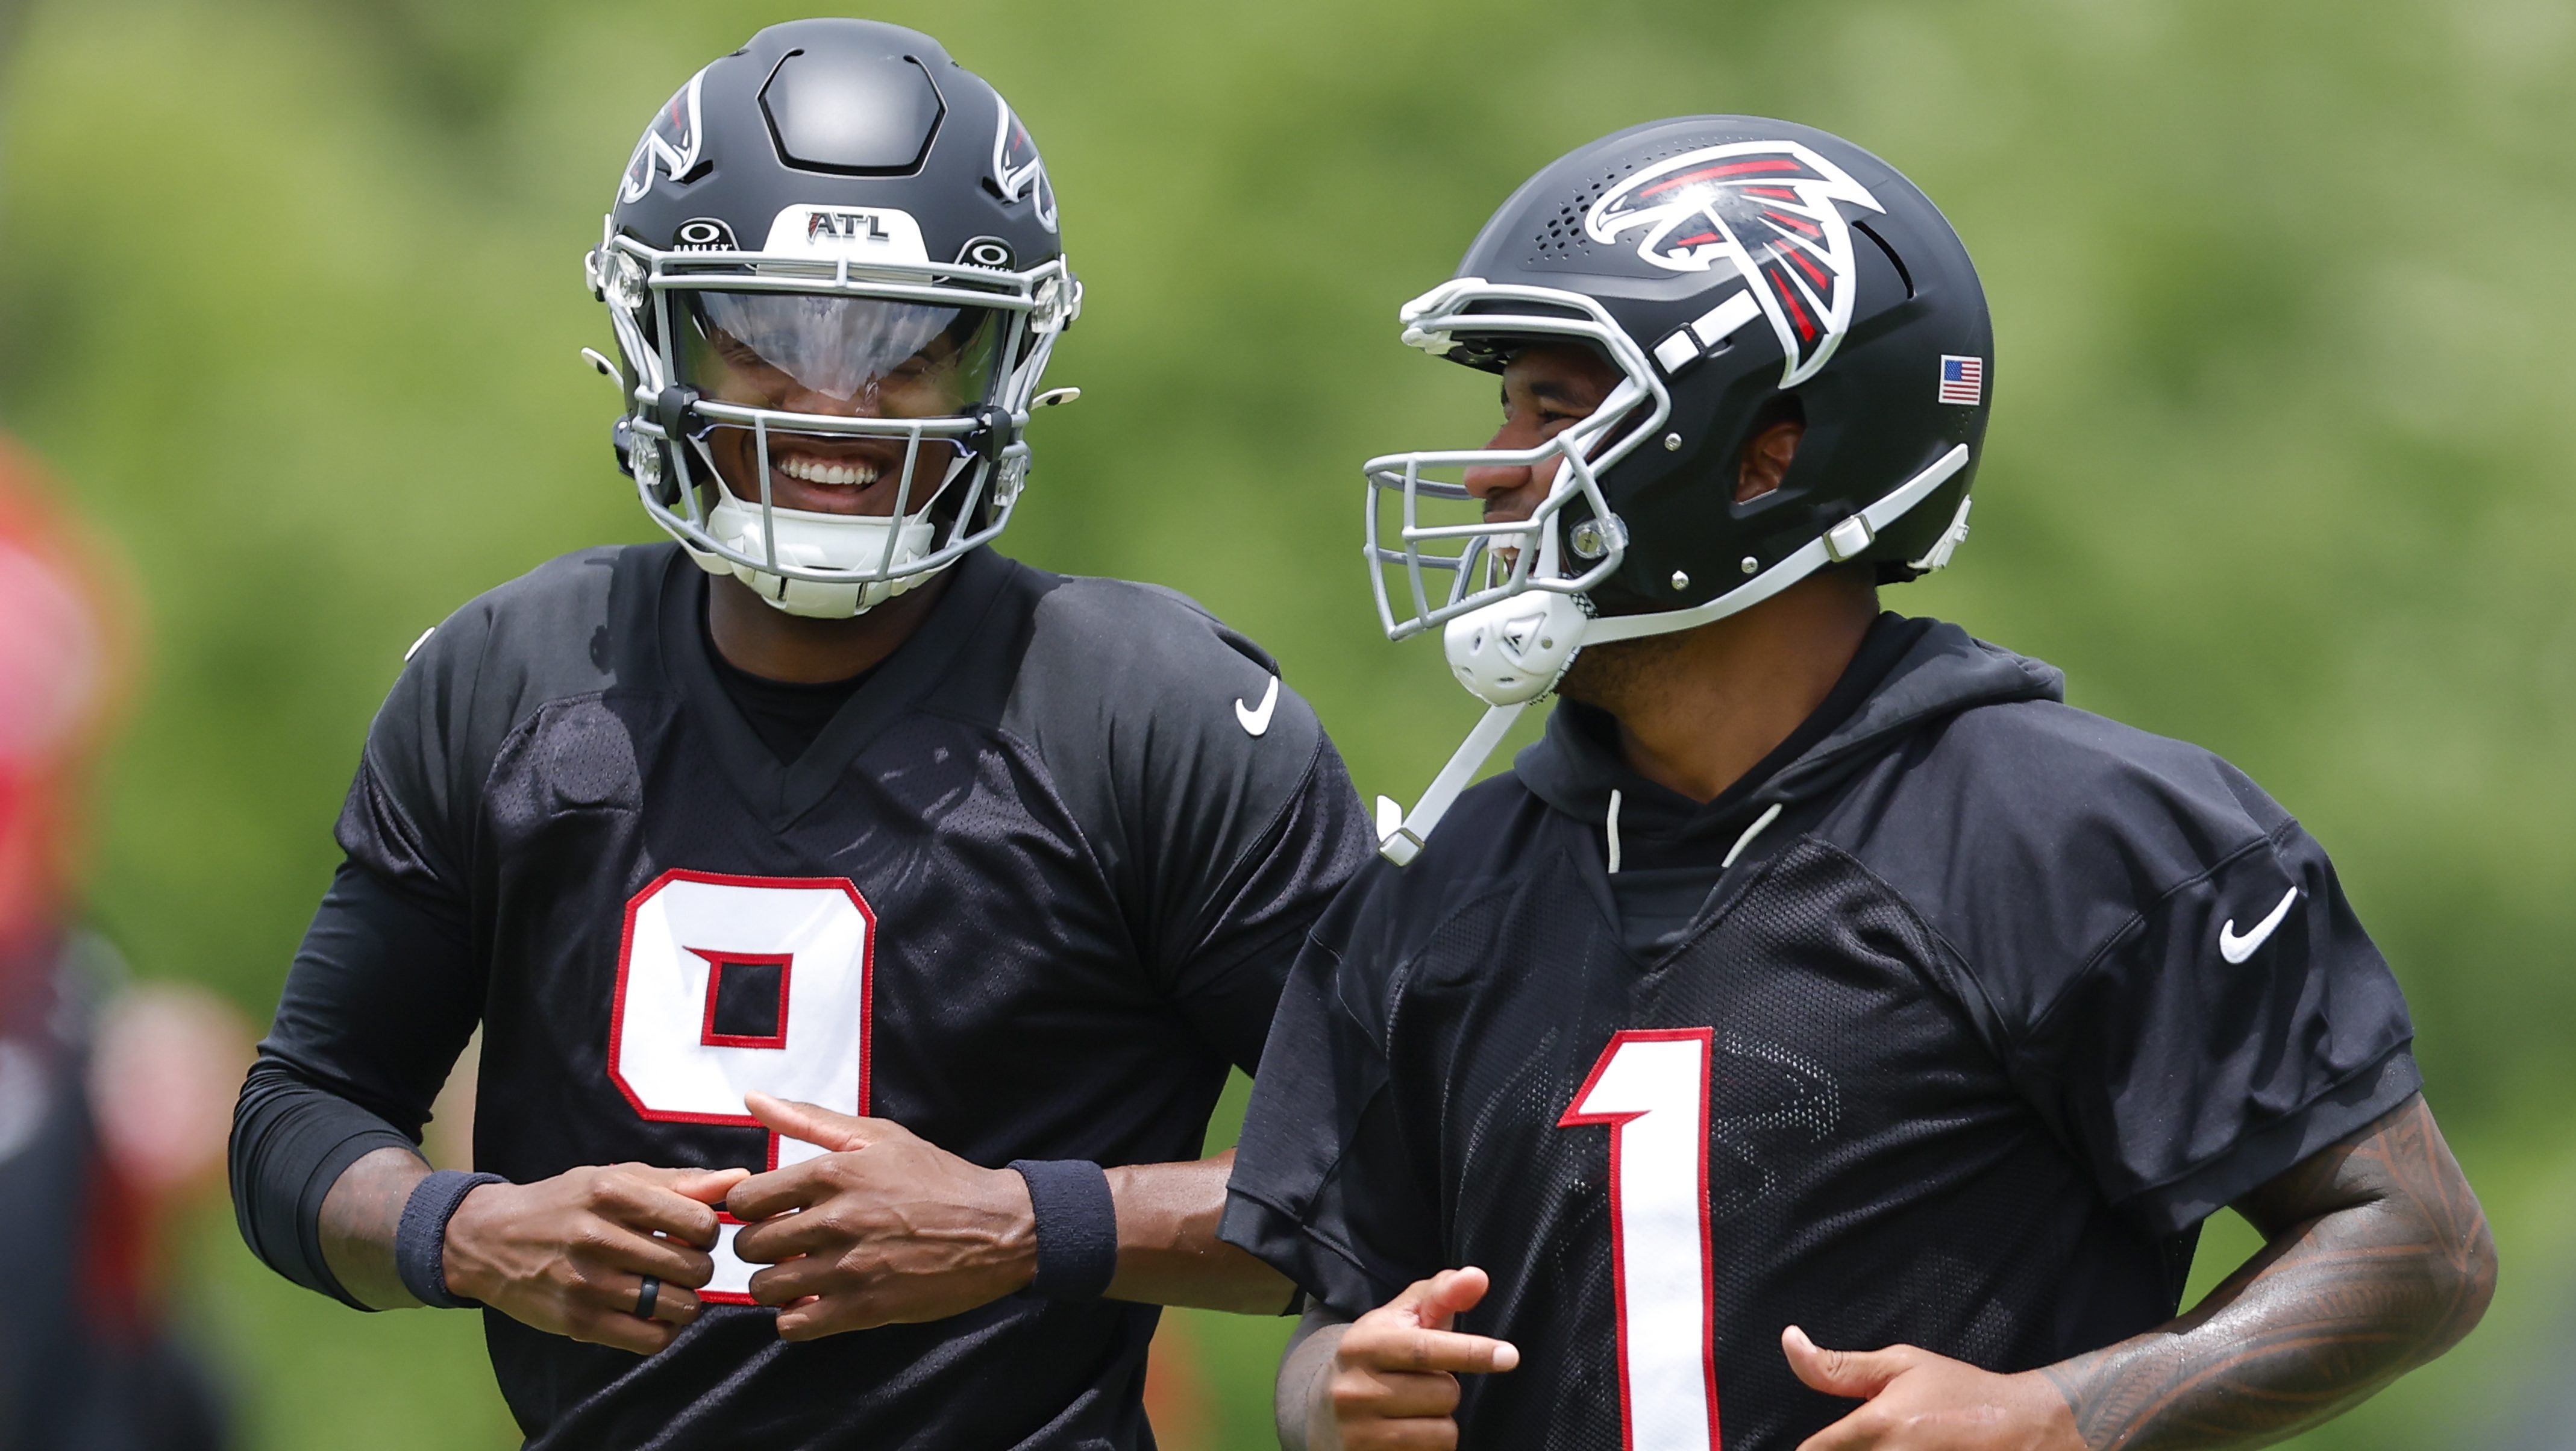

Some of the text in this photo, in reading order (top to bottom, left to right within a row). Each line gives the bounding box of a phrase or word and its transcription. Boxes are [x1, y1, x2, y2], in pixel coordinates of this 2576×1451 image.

[807, 212, 889, 243] ATL
[607, 868, 877, 1306] 9
[1557, 1026, 1722, 1451] 1
